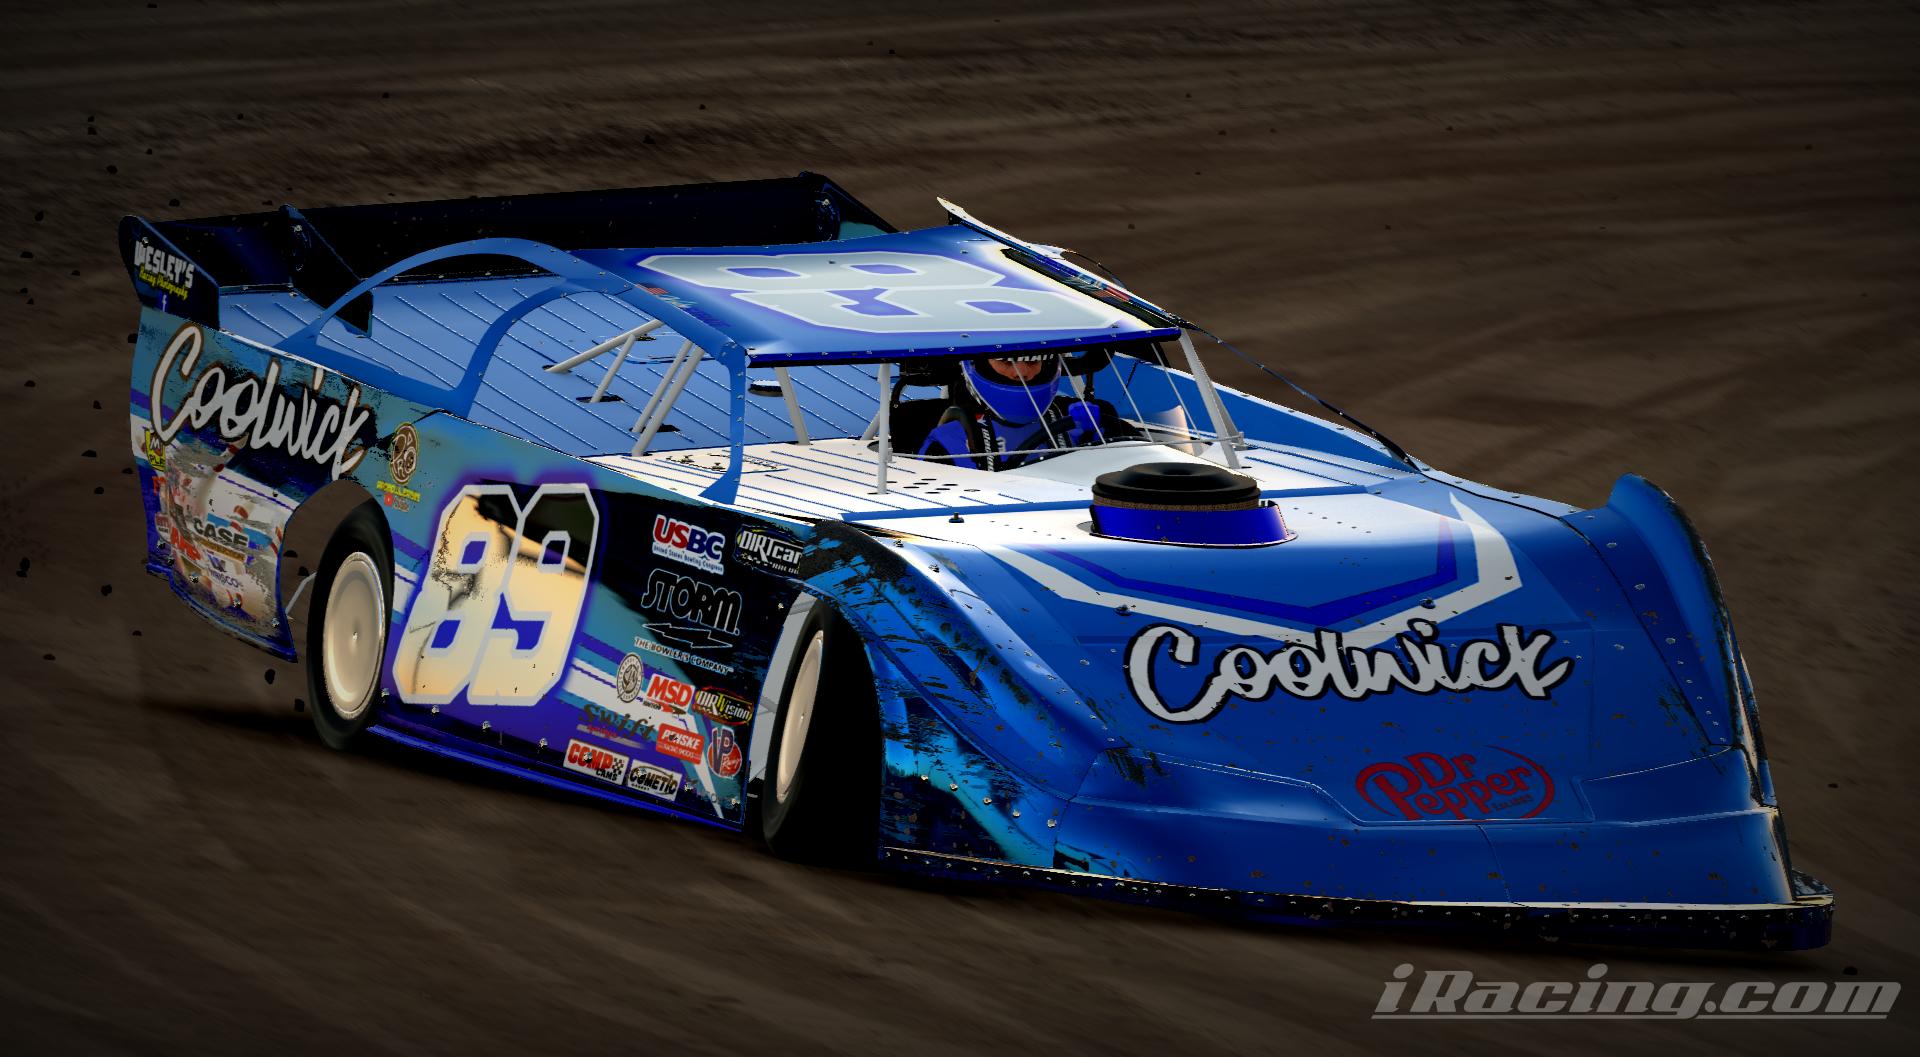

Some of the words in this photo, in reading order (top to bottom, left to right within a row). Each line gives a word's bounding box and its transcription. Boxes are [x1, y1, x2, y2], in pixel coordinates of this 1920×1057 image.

[134, 240, 195, 288] WESLEY'S
[152, 323, 370, 481] Coolwick
[654, 515, 725, 561] USBC
[392, 483, 599, 706] 89
[640, 568, 742, 635] STORM
[635, 638, 650, 649] THE
[690, 655, 729, 676] COMPANY
[1126, 618, 1575, 723] Coolwick
[647, 676, 692, 707] MSD
[567, 743, 614, 770] COMP
[596, 768, 618, 782] CAMS
[711, 727, 735, 775] VP
[1407, 752, 1476, 789] Dr
[1356, 762, 1531, 820] Pepper
